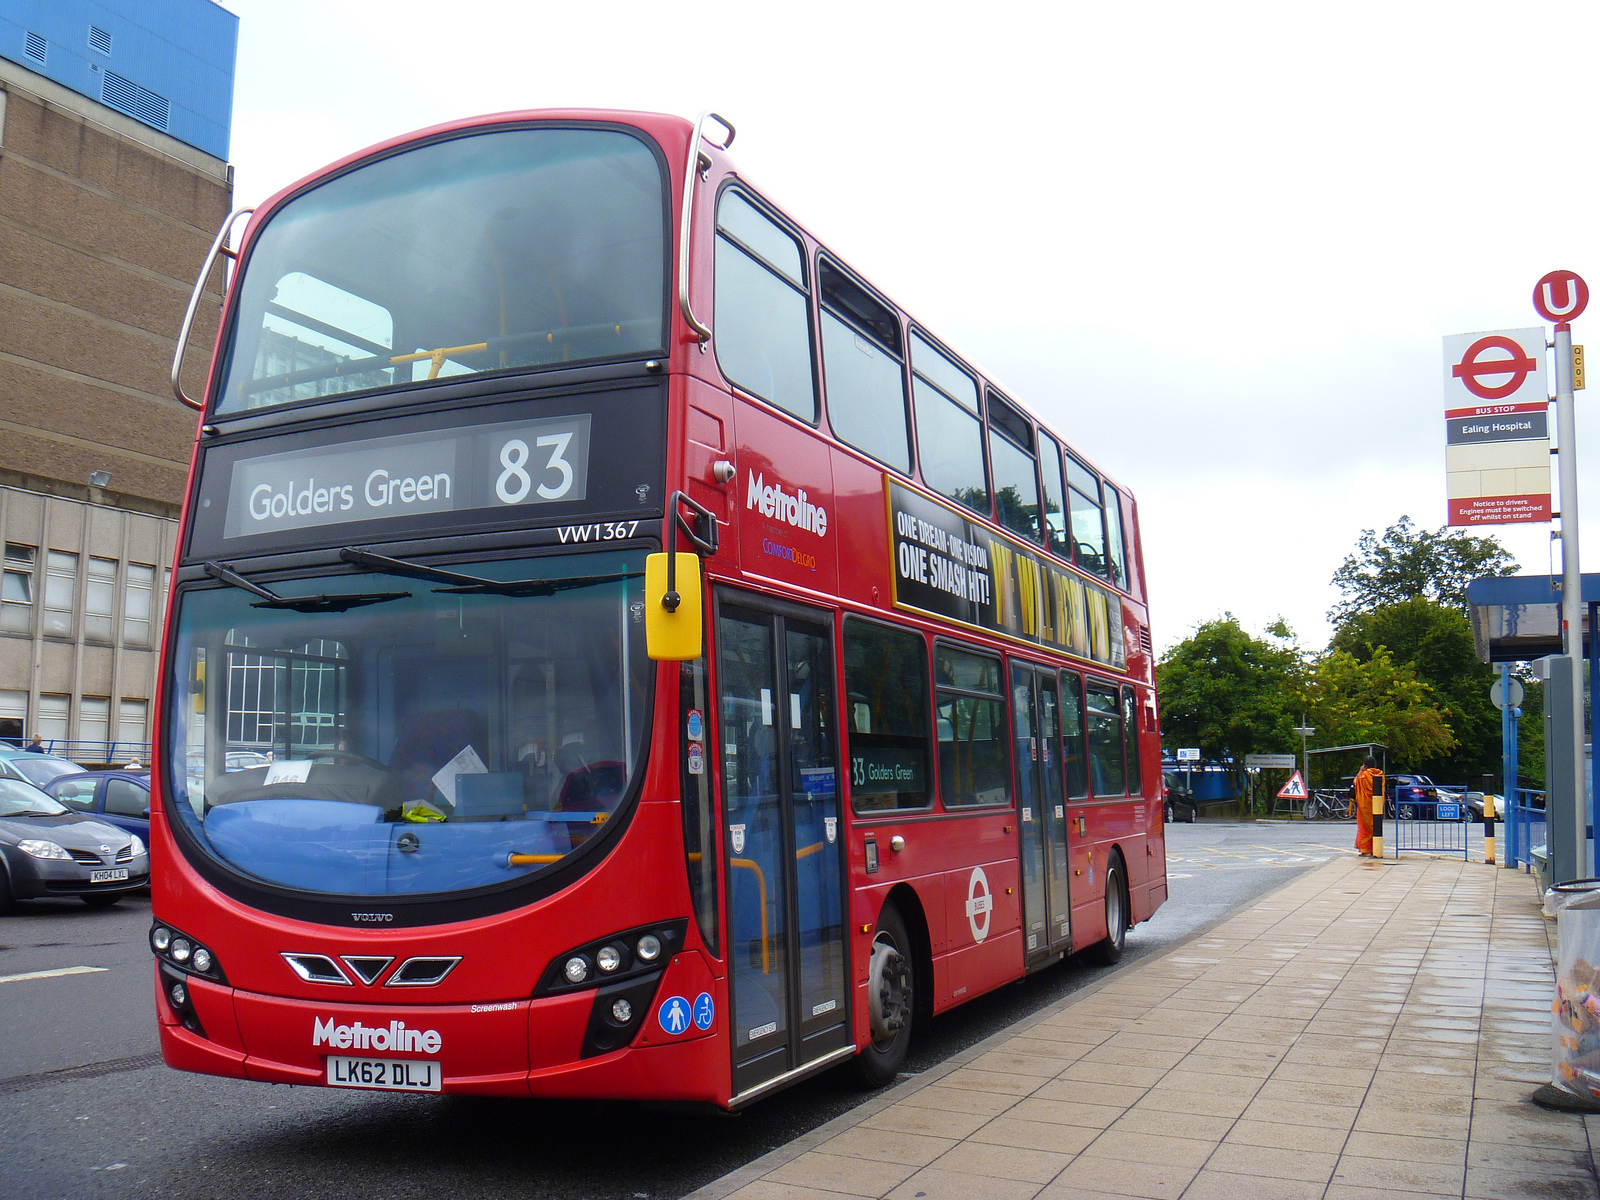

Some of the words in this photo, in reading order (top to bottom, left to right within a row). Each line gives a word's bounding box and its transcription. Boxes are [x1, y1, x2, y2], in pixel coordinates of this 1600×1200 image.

[1542, 279, 1577, 315] U
[1475, 407, 1492, 415] BUS
[1494, 405, 1515, 413] STOP
[1462, 424, 1490, 434] Ealing
[1492, 421, 1532, 432] Hospital
[495, 432, 574, 504] 83
[249, 478, 354, 521] Golders
[364, 468, 451, 507] Green
[746, 467, 828, 538] Metroline
[557, 520, 640, 544] VW1367
[897, 511, 918, 541] ONE
[918, 519, 947, 553] DREAM
[949, 534, 963, 561] ONE
[963, 541, 988, 570] VISION
[899, 541, 928, 585] ONE
[930, 552, 967, 600] SMASH
[968, 570, 990, 606] HIT!
[868, 762, 894, 780] Golders
[895, 763, 914, 780] Green
[94, 871, 113, 881] KH04
[351, 912, 394, 922] VOLVO
[470, 1002, 518, 1013] Screenwash
[312, 1015, 442, 1054] Metroline
[335, 1060, 386, 1085] LK62
[392, 1063, 431, 1087] DLJ
